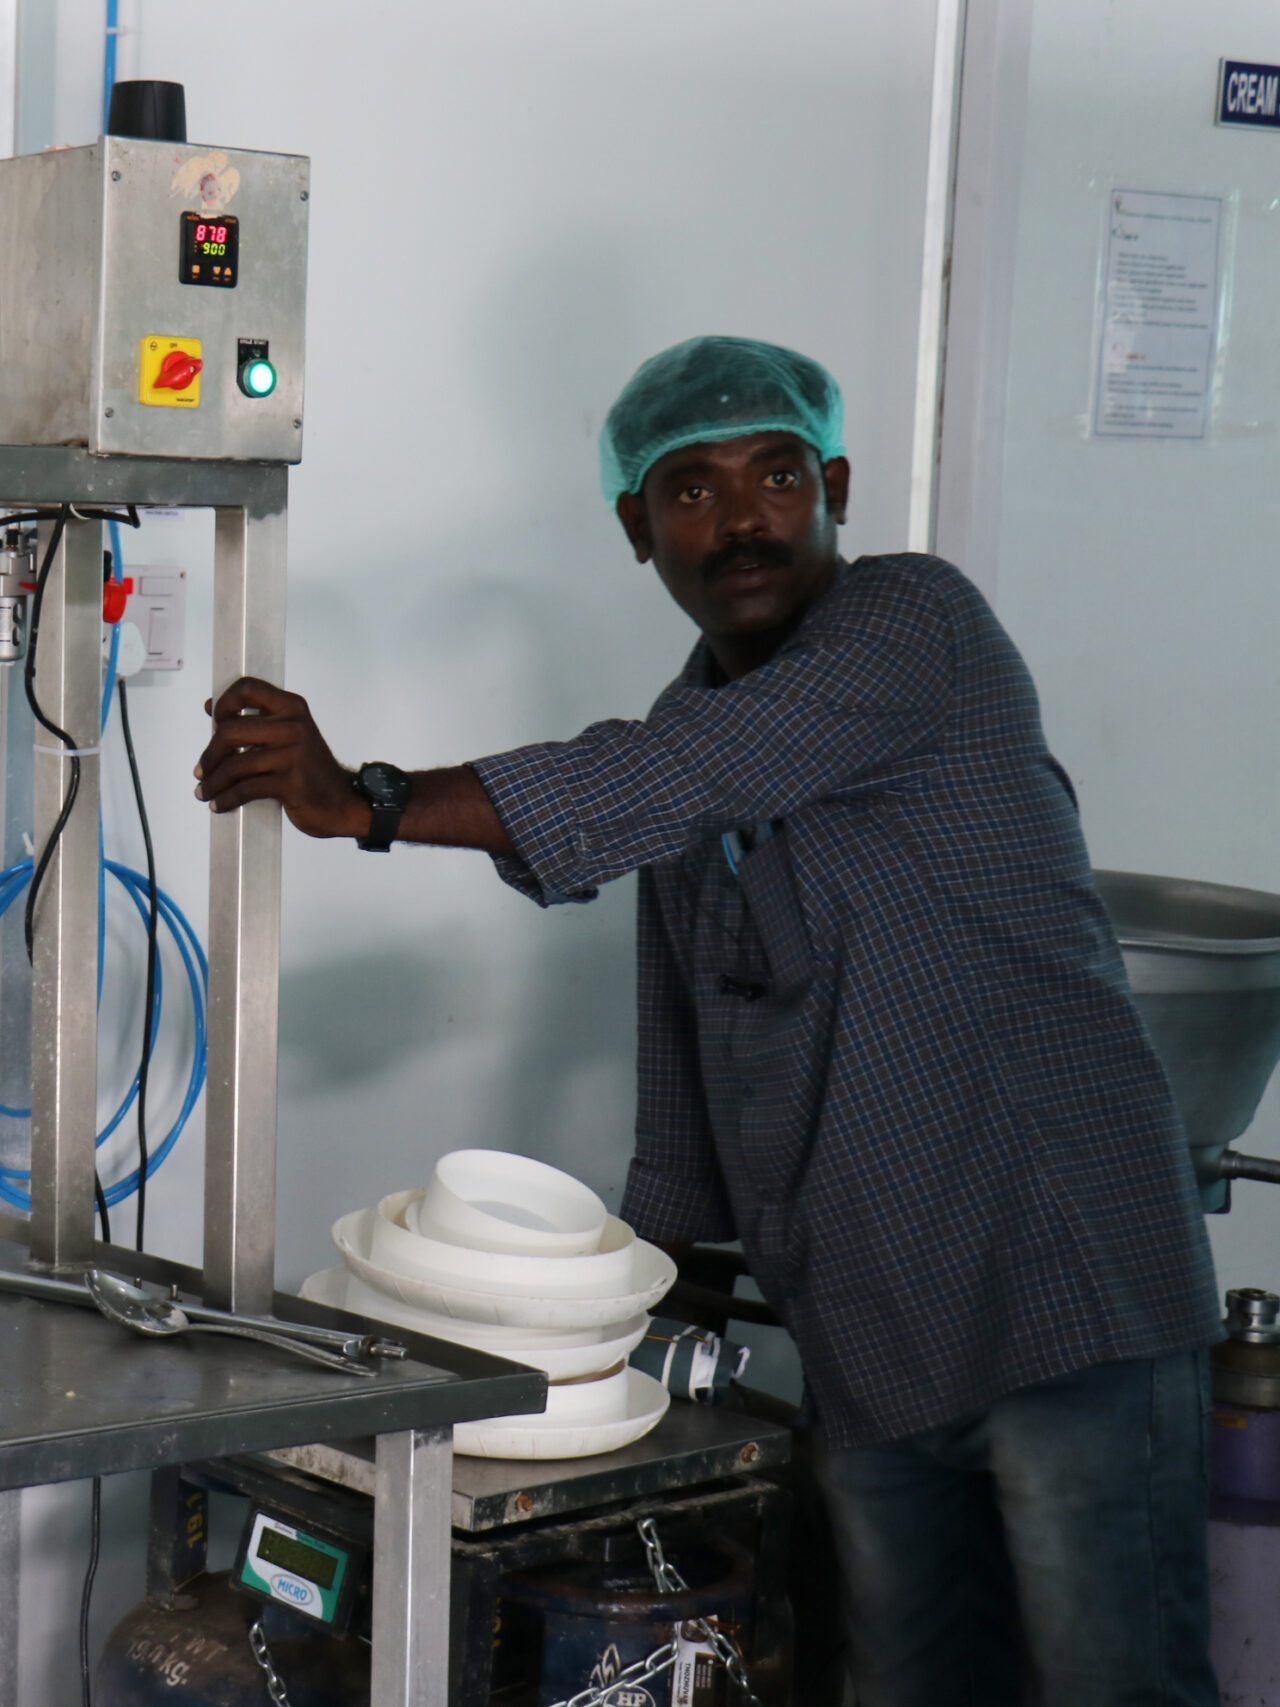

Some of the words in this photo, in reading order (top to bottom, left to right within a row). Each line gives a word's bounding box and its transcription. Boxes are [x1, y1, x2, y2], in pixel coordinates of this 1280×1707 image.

[1227, 71, 1279, 116] CREAM
[195, 224, 228, 243] 878
[202, 242, 226, 256] 900
[277, 1578, 308, 1601] MICRO
[616, 1691, 646, 1707] HP
